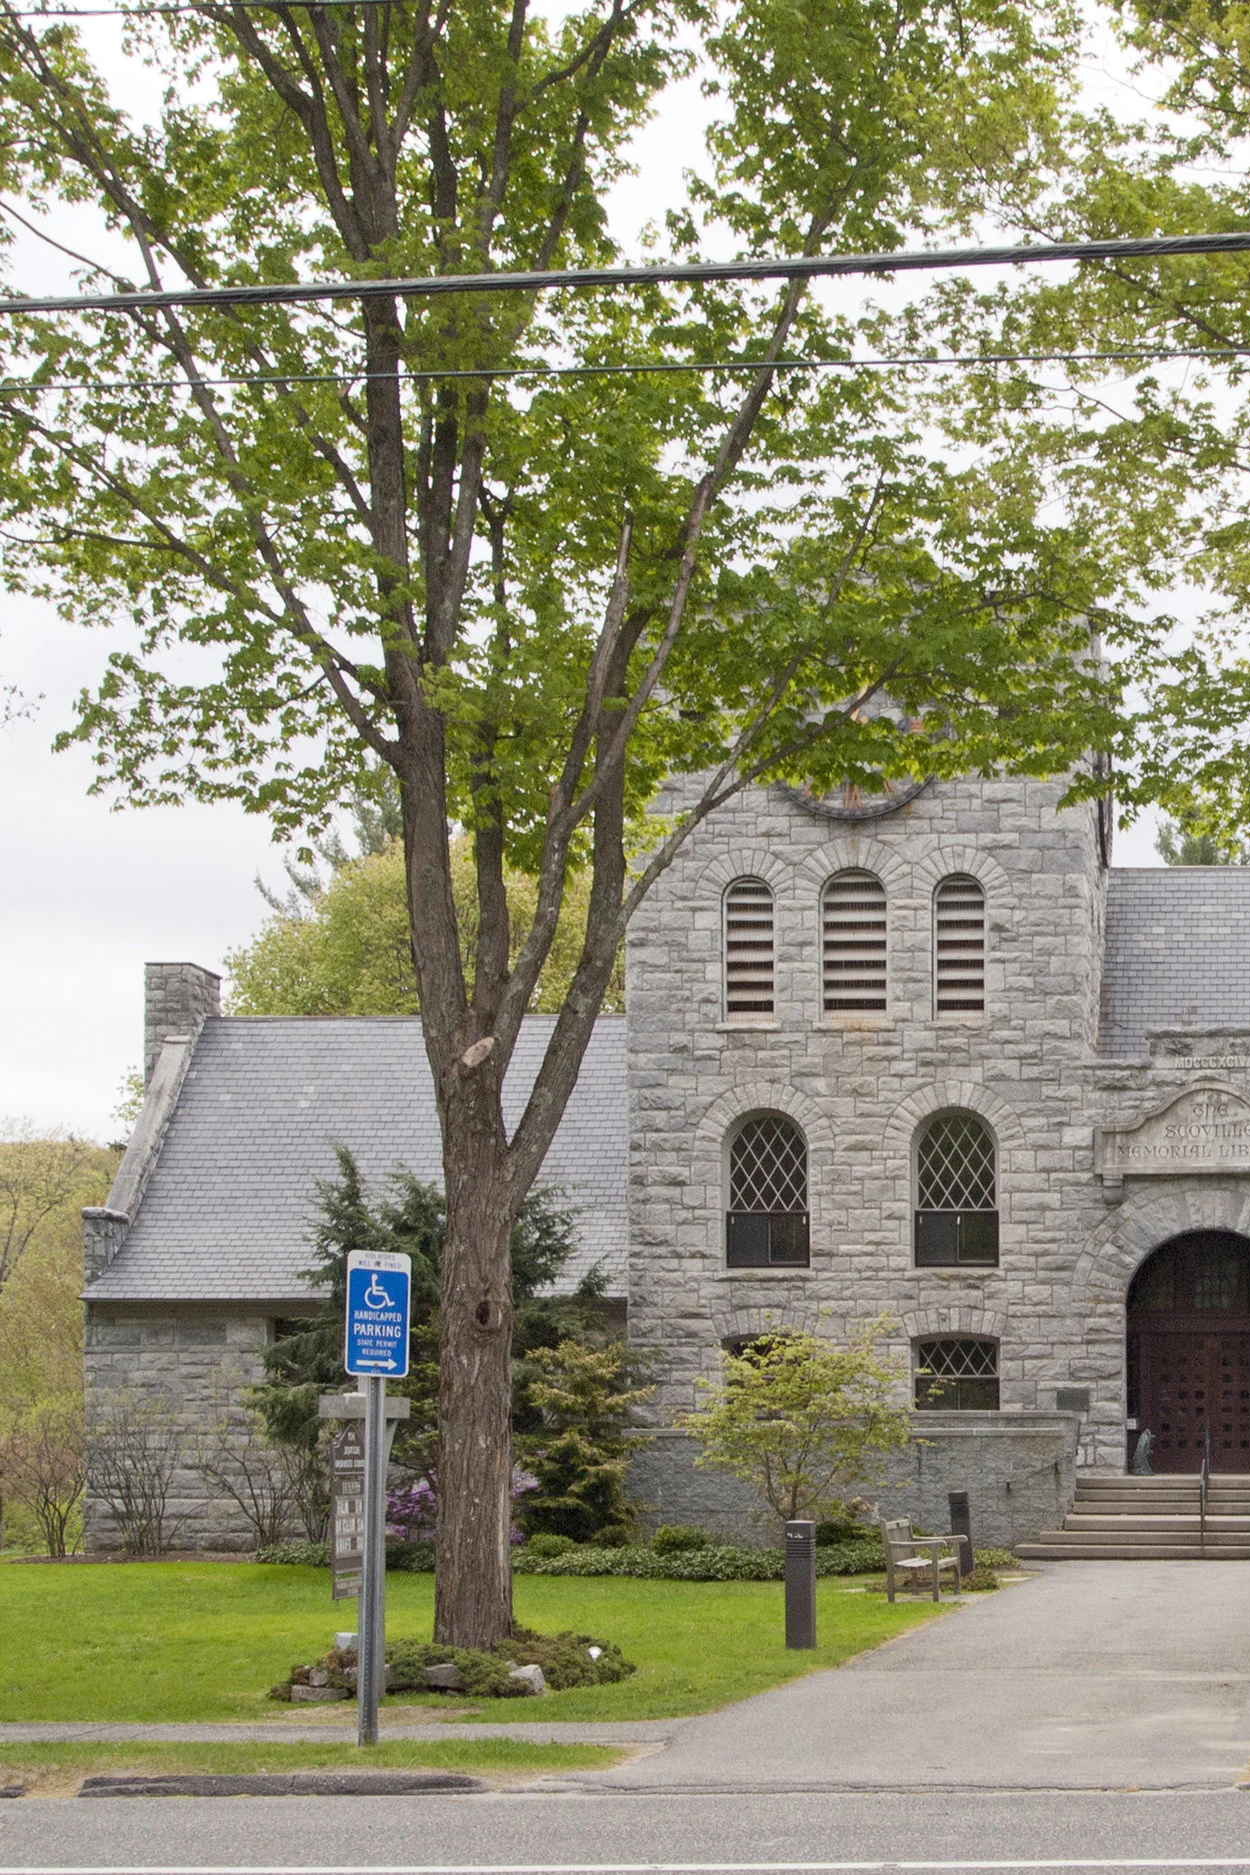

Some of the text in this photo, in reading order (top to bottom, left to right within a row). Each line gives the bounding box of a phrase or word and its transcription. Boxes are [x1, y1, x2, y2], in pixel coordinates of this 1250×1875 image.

[1174, 1055, 1247, 1069] MDCCCXCIV
[1191, 1102, 1229, 1118] THE
[1117, 1143, 1211, 1159] MEMORIAL
[354, 1310, 402, 1323] HANDICAPPED
[353, 1323, 402, 1338] PARKING
[357, 1338, 397, 1348] STATE PERMIT
[361, 1348, 392, 1358] REQUIRED
